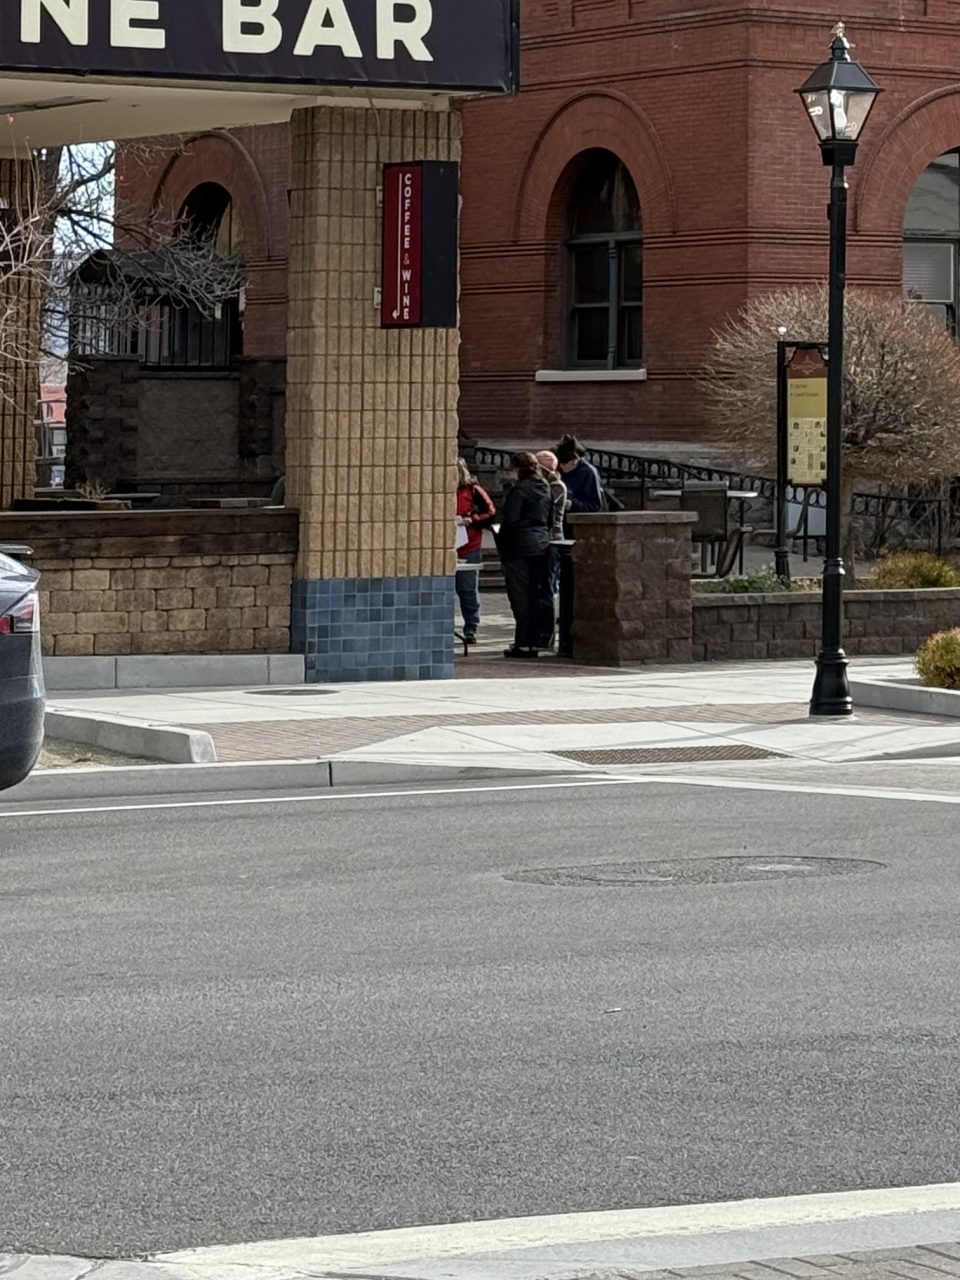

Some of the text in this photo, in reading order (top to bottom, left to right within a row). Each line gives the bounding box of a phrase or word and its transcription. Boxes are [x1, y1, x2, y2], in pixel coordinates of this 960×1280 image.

[402, 173, 412, 320] COFFEE & WINE
